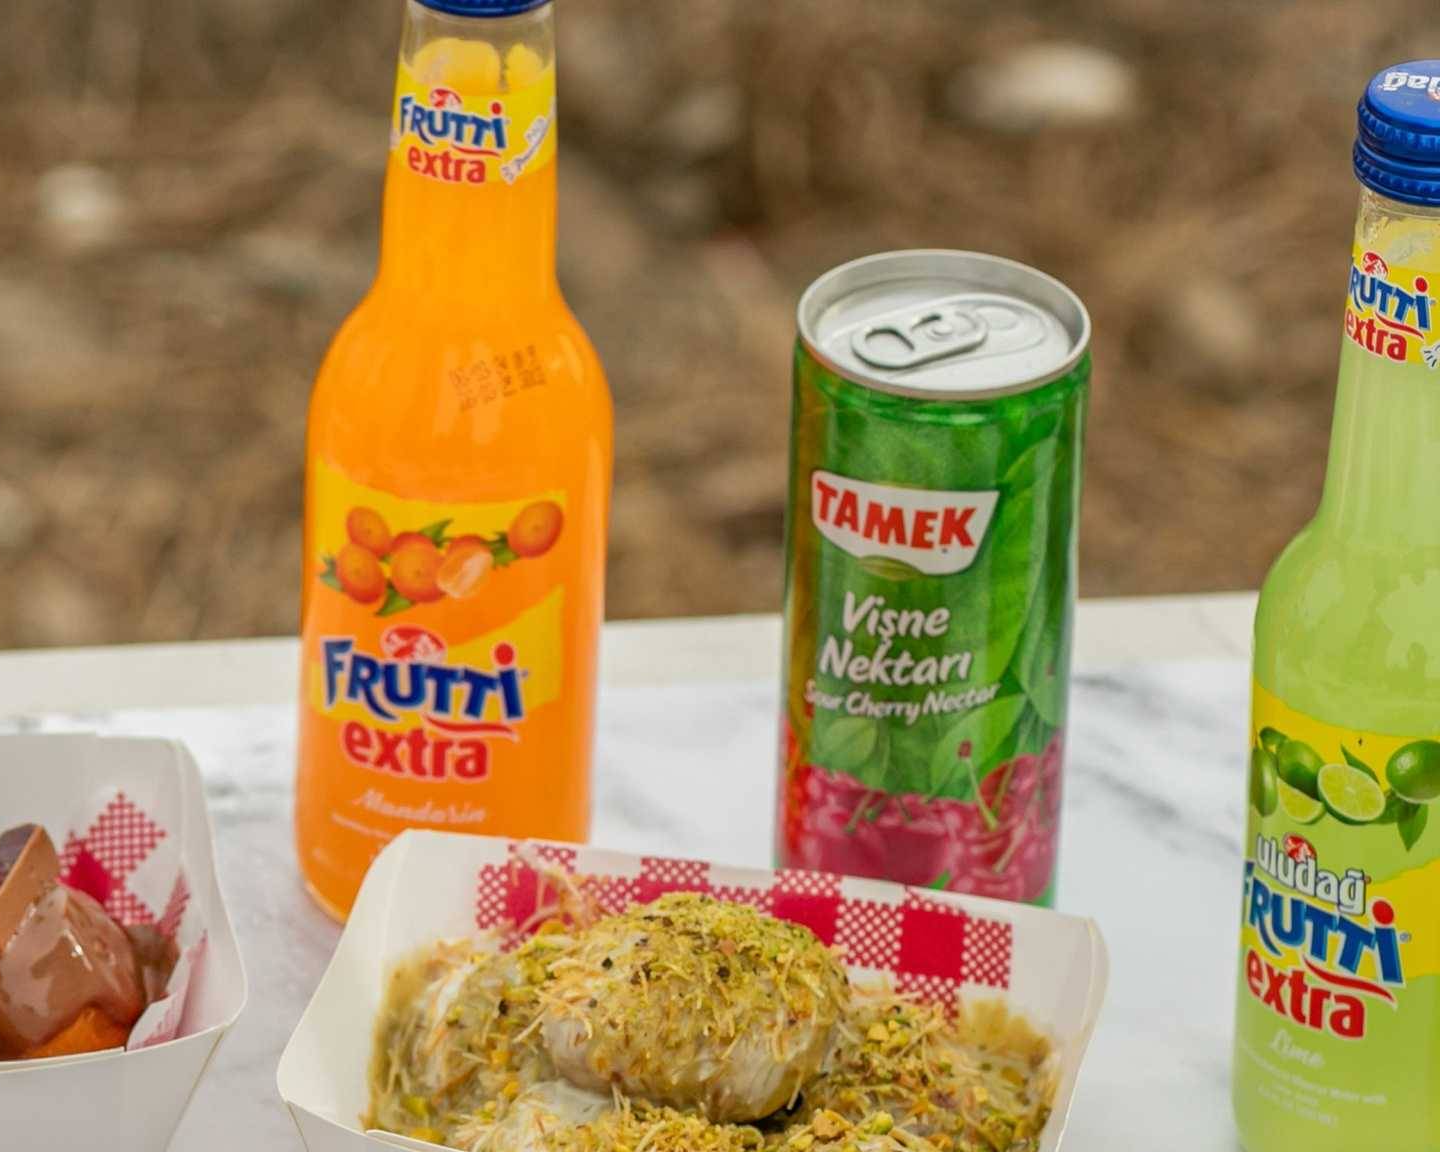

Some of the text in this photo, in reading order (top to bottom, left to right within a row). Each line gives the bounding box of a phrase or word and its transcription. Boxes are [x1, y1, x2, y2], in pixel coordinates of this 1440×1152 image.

[400, 95, 507, 149] FRUTTI
[408, 146, 487, 184] extra
[1350, 264, 1429, 329] RUTTI
[1346, 308, 1408, 361] extra
[816, 480, 977, 550] TAMEK
[843, 591, 951, 640] Vişne
[323, 639, 524, 721] FRUTTI
[819, 635, 973, 686] Nektarı
[846, 691, 920, 726] Cherry
[923, 683, 1001, 715] Nectar
[344, 721, 488, 779] extra
[1246, 949, 1366, 1039] extra
